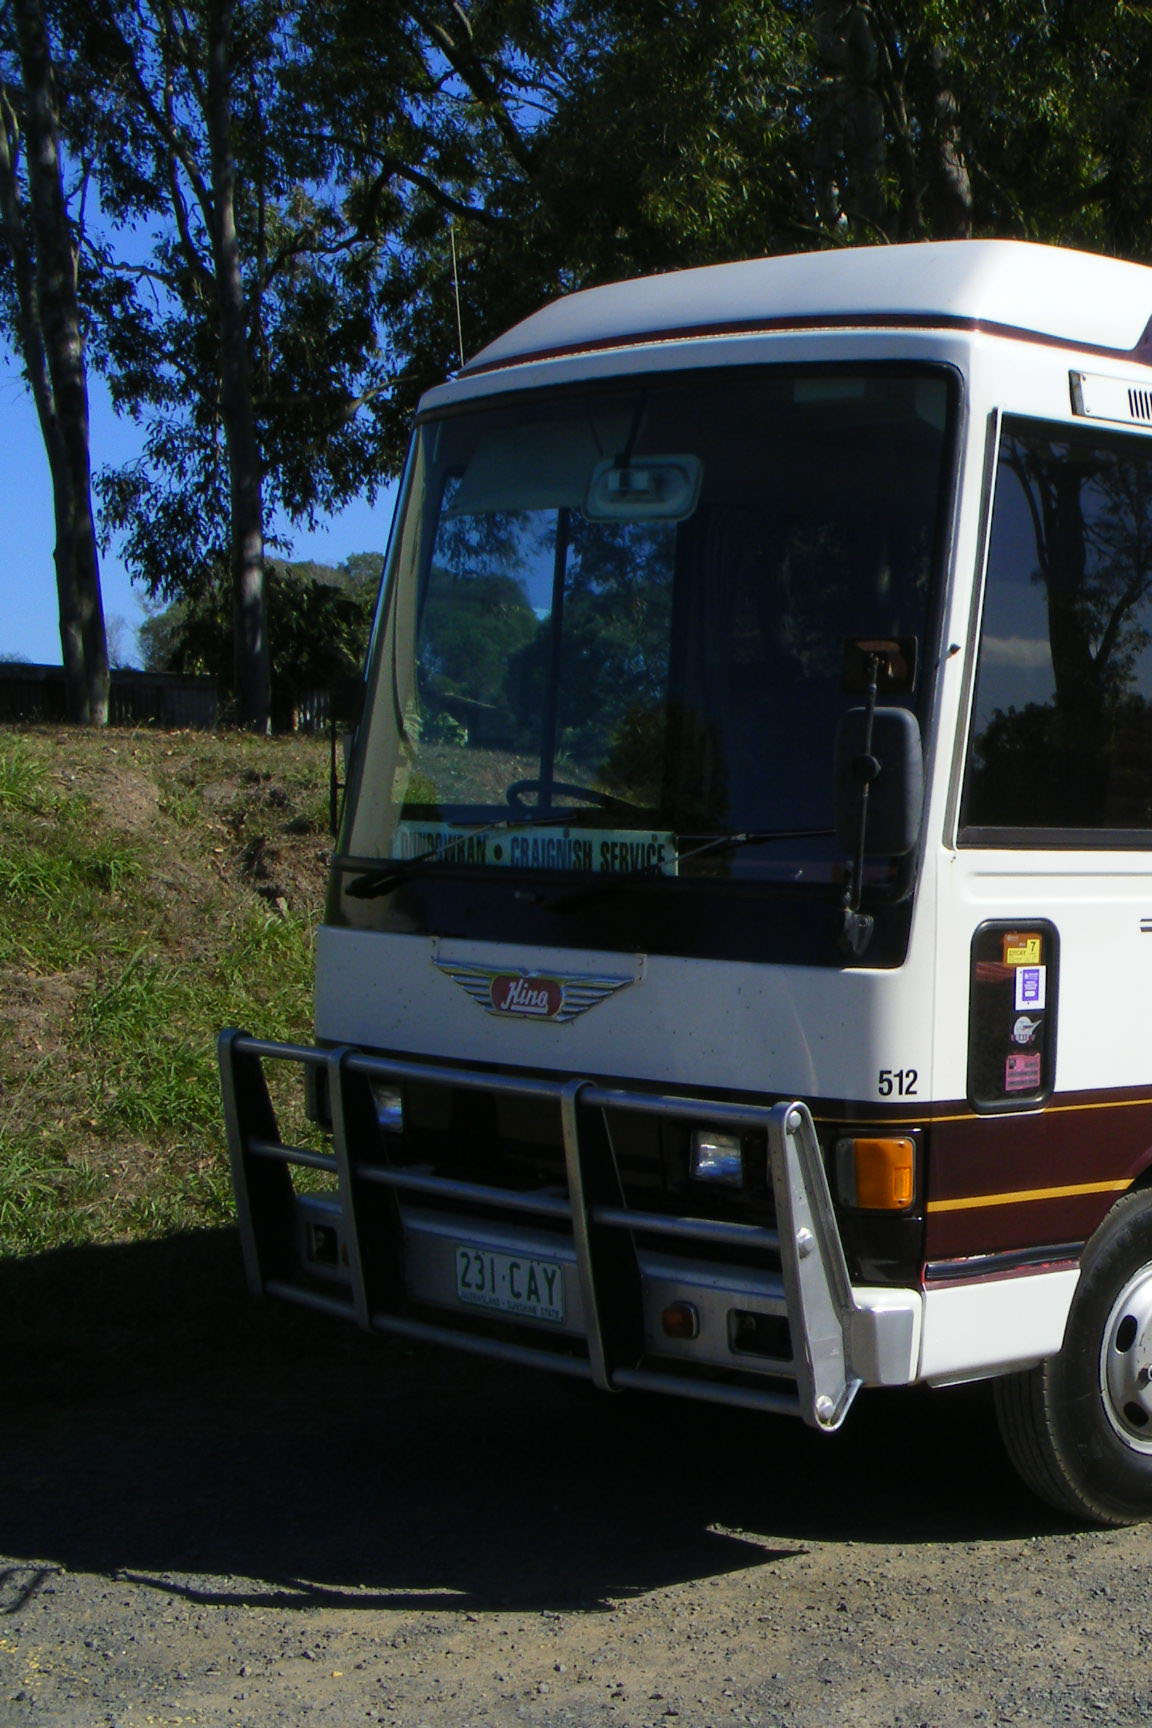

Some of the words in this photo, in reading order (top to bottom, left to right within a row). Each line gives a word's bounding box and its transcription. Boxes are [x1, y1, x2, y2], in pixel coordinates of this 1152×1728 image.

[511, 836, 593, 872] CRAIGNISH
[600, 841, 666, 875] SERVICE
[1030, 941, 1036, 952] 7
[501, 979, 549, 1011] Hino
[878, 1069, 918, 1096] 512
